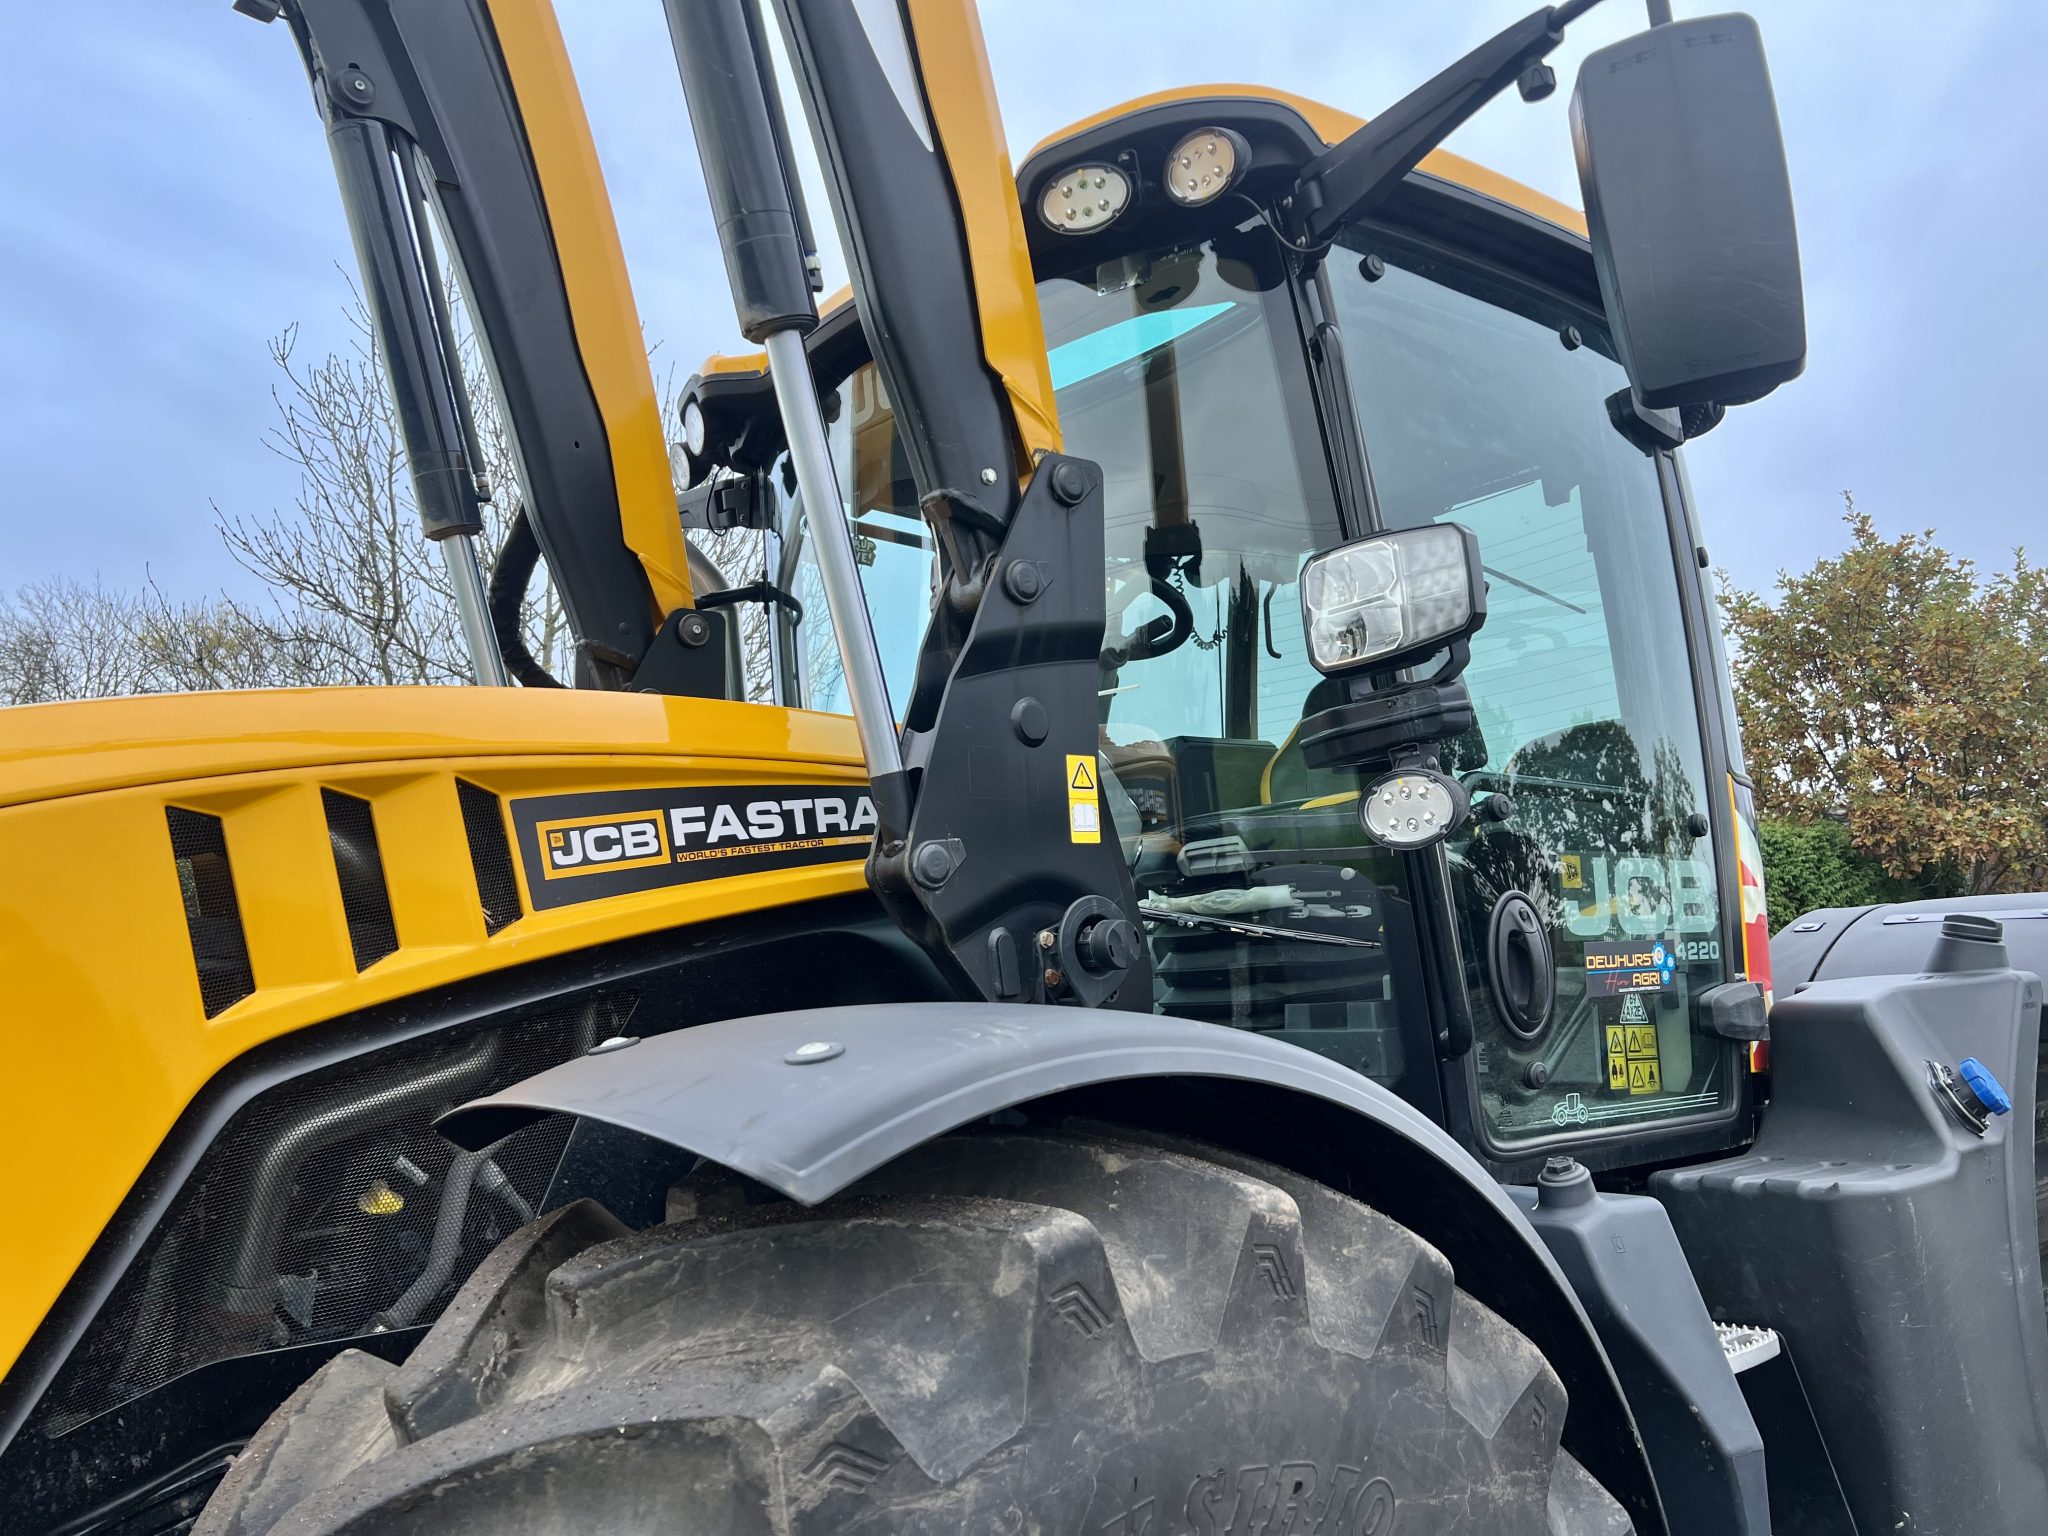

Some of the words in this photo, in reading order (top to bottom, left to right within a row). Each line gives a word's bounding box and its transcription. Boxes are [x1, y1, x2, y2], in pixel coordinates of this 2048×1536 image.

[552, 822, 660, 866] JCB
[670, 796, 879, 847] FASTRA
[677, 848, 728, 862] WORLD'S
[731, 843, 776, 856] FASTEST
[779, 839, 825, 849] TRACTOR
[1564, 856, 1717, 936] JCB
[1675, 941, 1720, 960] 4220
[1632, 971, 1661, 986] AGRI
